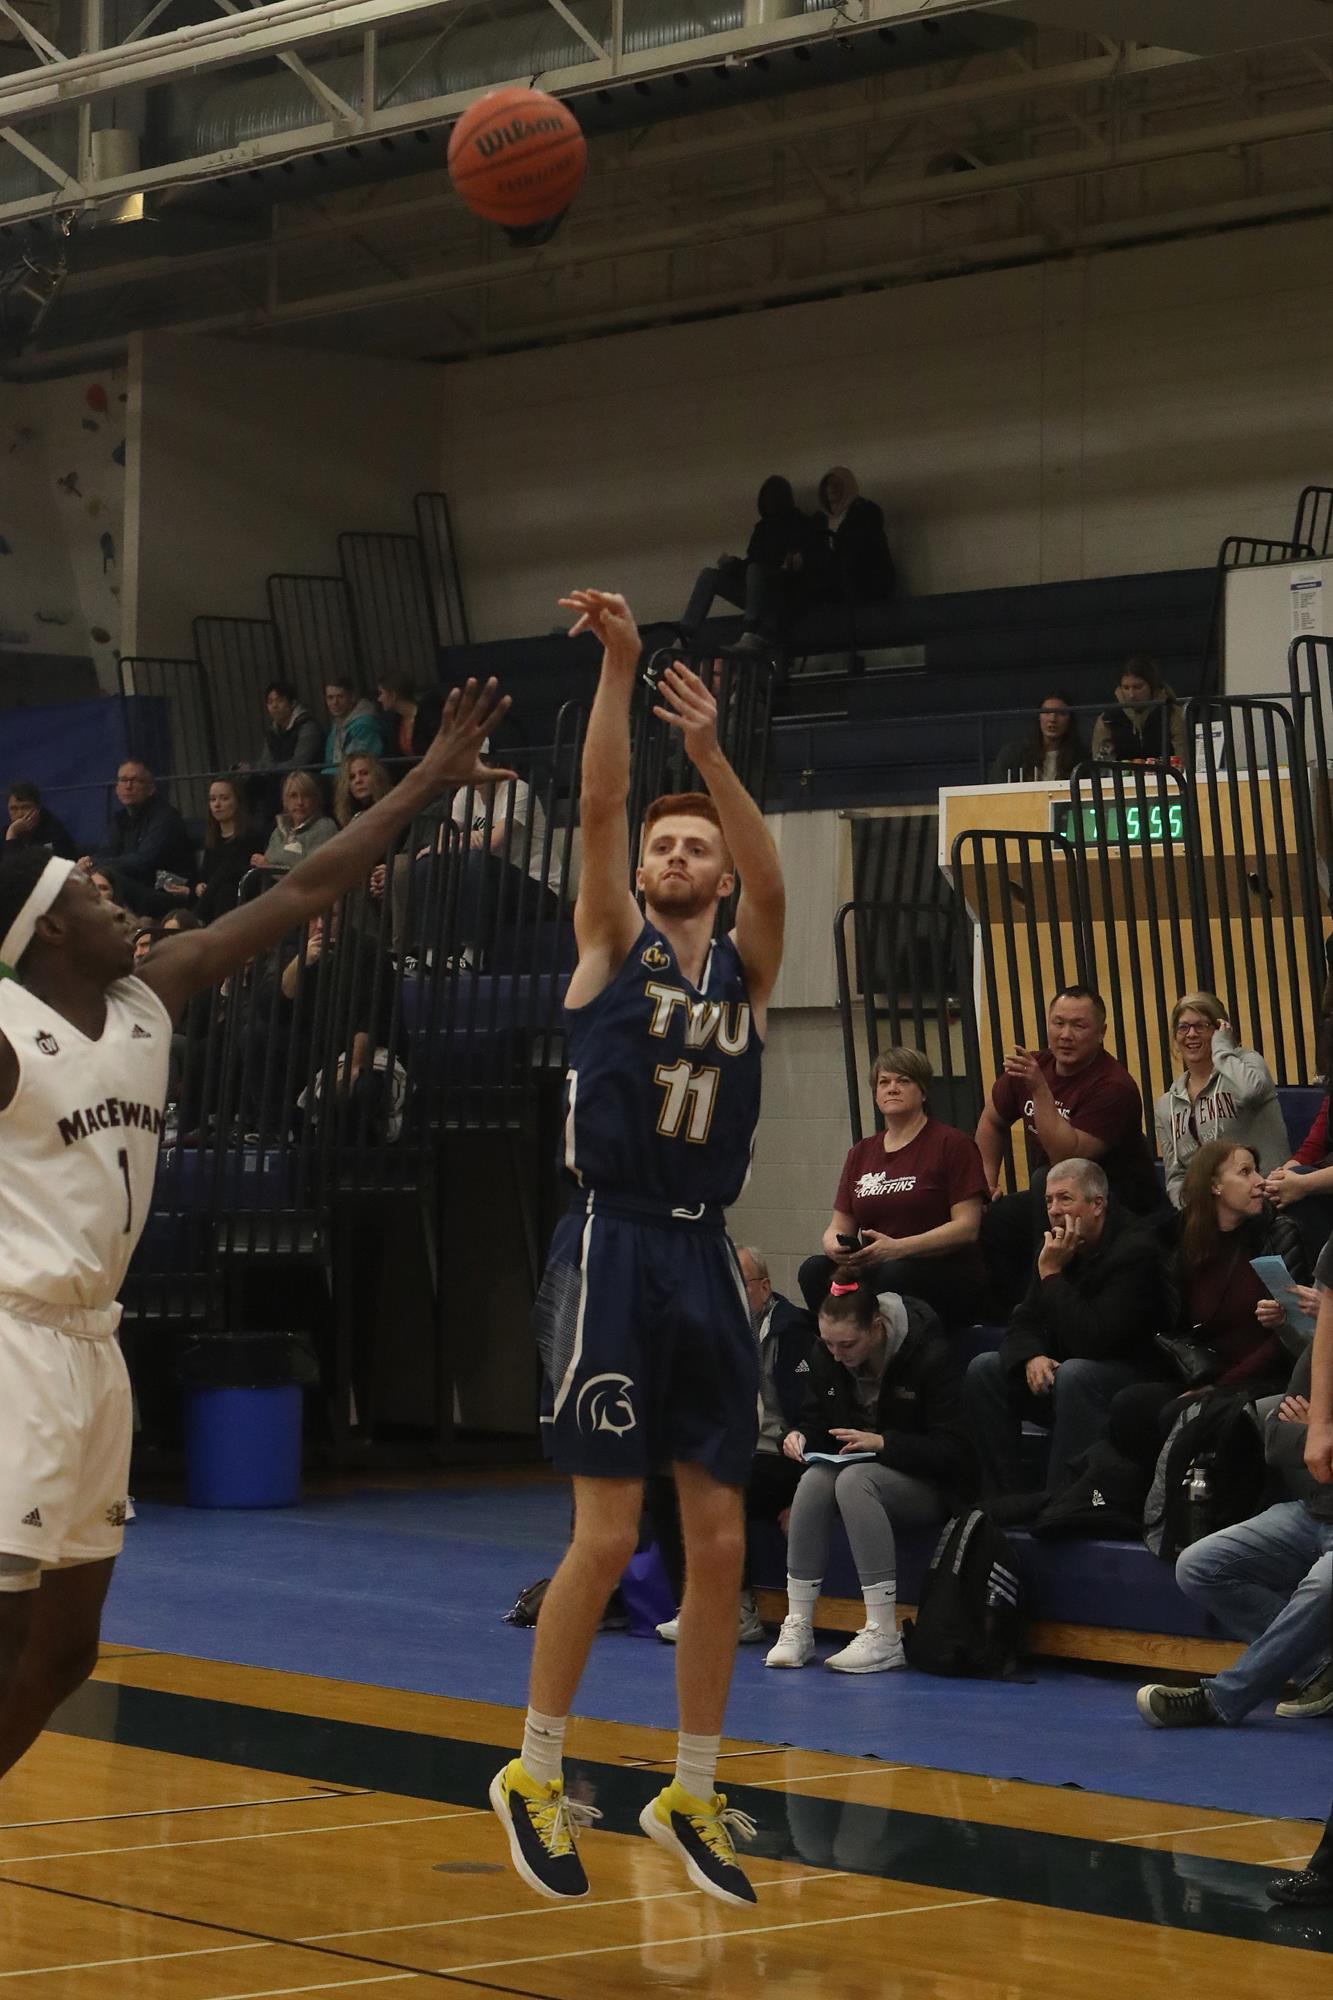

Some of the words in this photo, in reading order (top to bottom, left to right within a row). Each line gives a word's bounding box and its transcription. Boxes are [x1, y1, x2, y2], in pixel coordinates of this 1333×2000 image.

[475, 118, 565, 158] Wilson
[645, 981, 750, 1055] TWU
[654, 1059, 720, 1144] 11
[117, 1147, 132, 1233] 1
[860, 1180, 916, 1197] GRIFFINS
